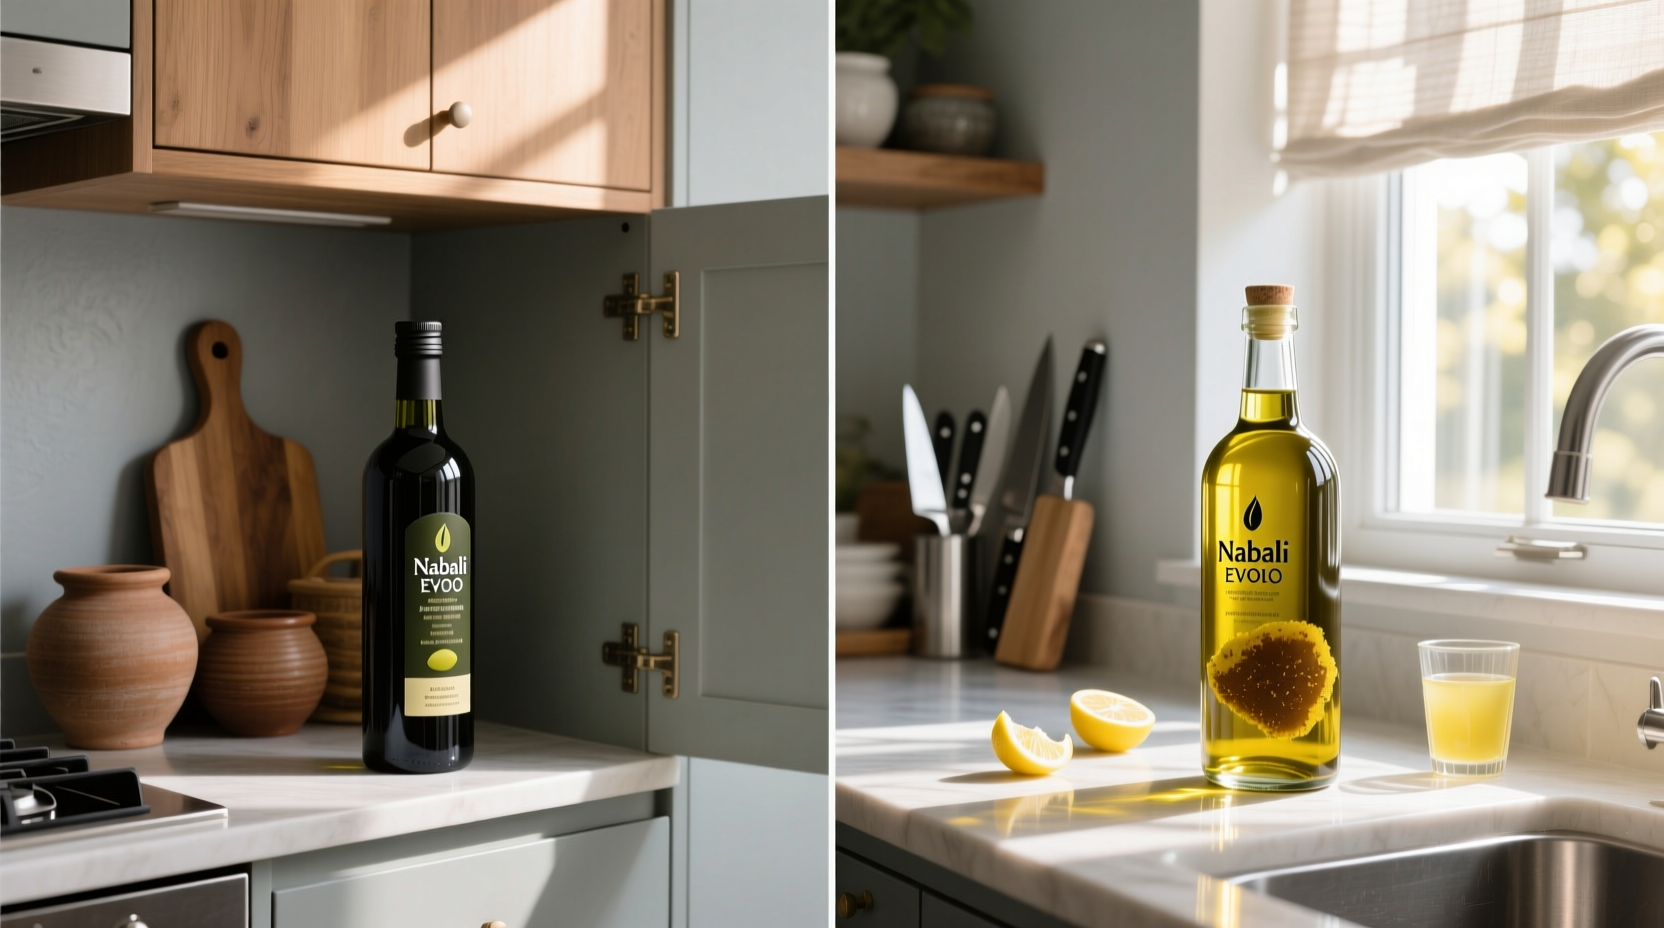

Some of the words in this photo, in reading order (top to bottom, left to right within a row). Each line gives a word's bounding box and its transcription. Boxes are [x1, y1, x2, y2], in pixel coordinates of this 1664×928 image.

[1218, 539, 1289, 563] Nabali
[414, 556, 467, 575] Nabali
[421, 577, 463, 593] EVOO
